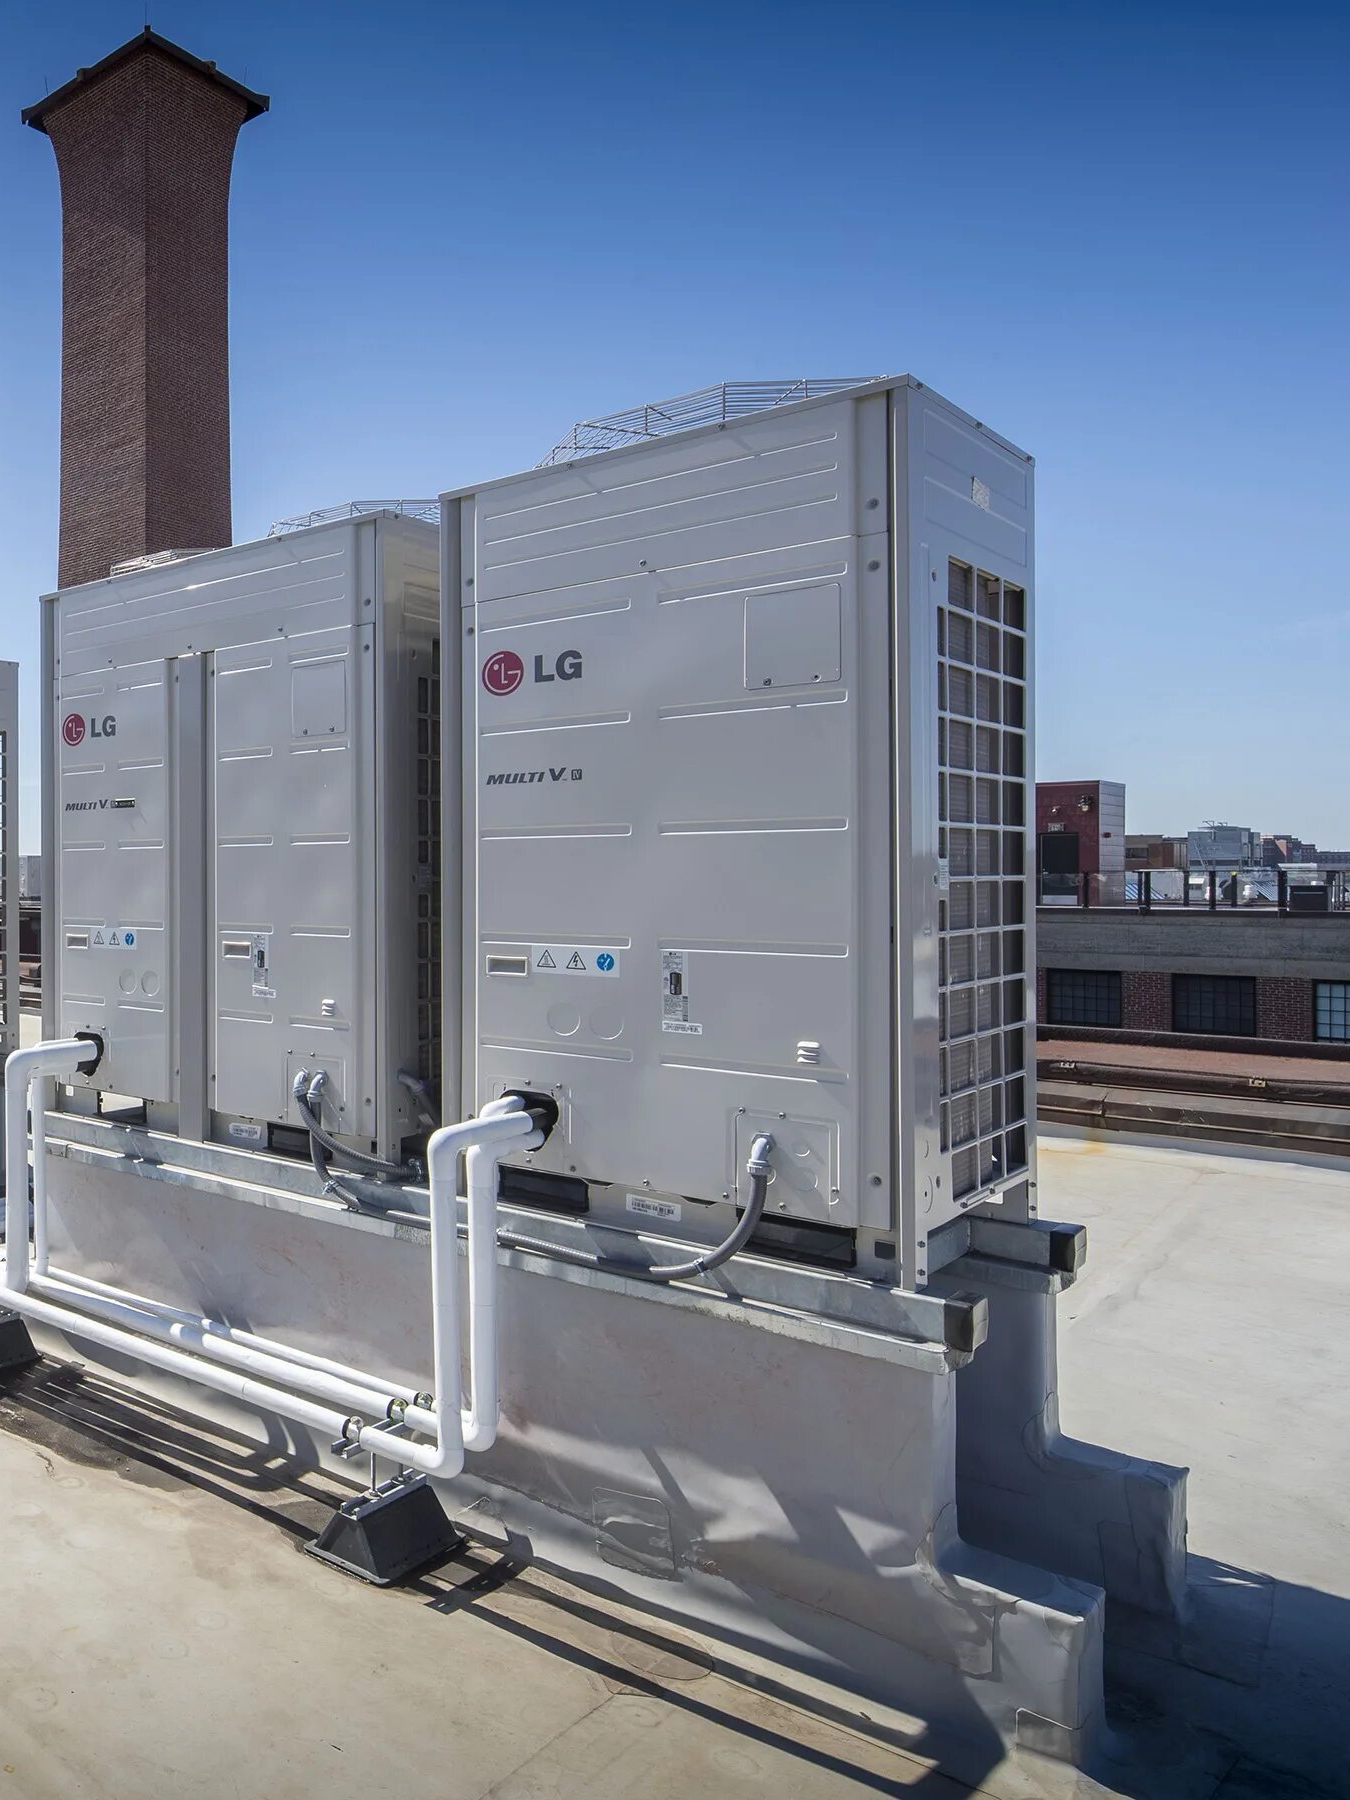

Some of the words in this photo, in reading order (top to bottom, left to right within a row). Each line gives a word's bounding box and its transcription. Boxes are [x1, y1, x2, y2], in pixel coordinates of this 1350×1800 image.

[534, 650, 582, 683] LG
[91, 715, 116, 738] LG
[486, 771, 545, 785] MULTI
[549, 767, 567, 782] V
[65, 802, 97, 811] MULTI
